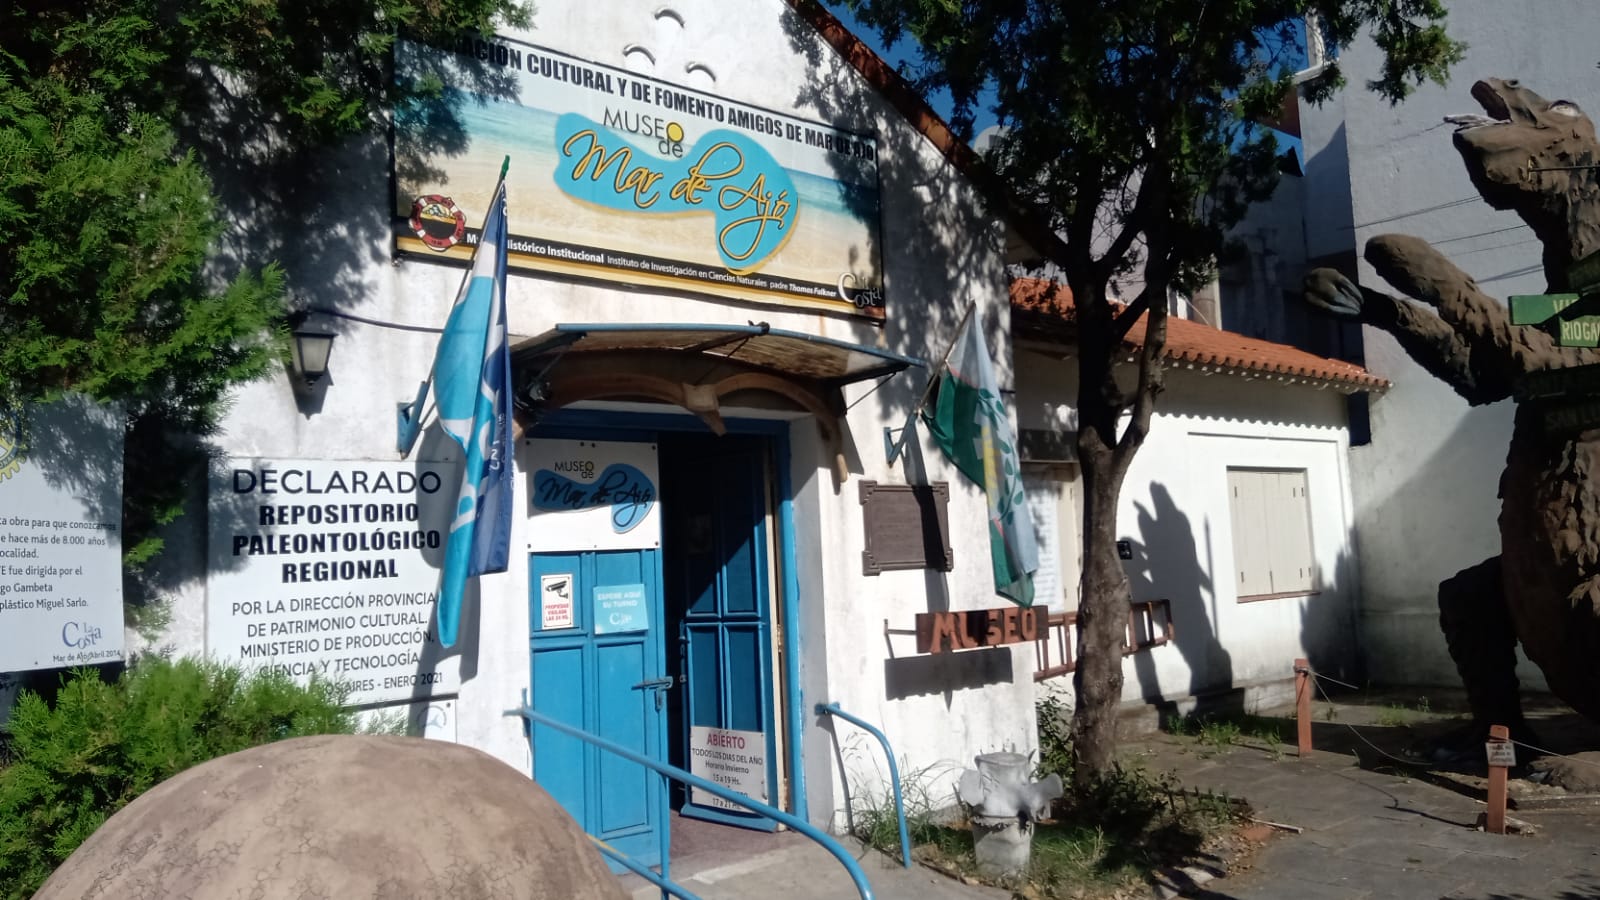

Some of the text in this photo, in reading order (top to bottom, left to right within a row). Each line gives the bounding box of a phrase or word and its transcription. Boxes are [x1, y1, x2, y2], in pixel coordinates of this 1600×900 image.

[526, 53, 614, 94] CULTURAL
[617, 78, 628, 97] Y
[631, 83, 651, 104] DE
[655, 88, 724, 122] FOMENTO
[728, 107, 783, 138] AMIGOS
[786, 123, 802, 142] DE
[805, 129, 833, 150] MAR
[836, 136, 851, 155] DE
[603, 106, 684, 143] MUSEO
[658, 138, 684, 159] de
[562, 129, 792, 261] Mar de Ajó
[547, 247, 604, 264] Institucional
[607, 255, 639, 269] Instituto
[640, 260, 650, 270] de
[651, 262, 697, 277] Investigación
[698, 271, 708, 279] en
[708, 271, 736, 283] Ciencias
[736, 275, 768, 287] Naturales
[769, 281, 789, 291] padre
[789, 283, 813, 294] Thomas
[838, 273, 882, 308] Costa
[1561, 321, 1582, 341] RIO
[554, 460, 594, 473] MUSEO
[581, 470, 594, 478] de
[233, 469, 442, 494] DECLARADO
[540, 477, 587, 509] Mar
[590, 470, 627, 503] de
[9, 516, 30, 526] obra
[31, 519, 50, 529] para
[52, 520, 68, 530] que
[259, 503, 419, 526] REPOSITORIO
[8, 532, 29, 543] hace
[31, 534, 48, 545] más
[50, 534, 60, 545] de
[62, 535, 85, 545] 8.000
[87, 536, 106, 546] años
[232, 528, 440, 556] PALEONTOLÓGICO
[8, 565, 23, 575] fue
[25, 565, 57, 578] dirigida
[59, 568, 72, 578] por
[74, 565, 82, 575] el
[282, 558, 399, 583] REGIONAL
[0, 582, 53, 595] go Gambeta
[36, 598, 64, 611] Miguel
[232, 592, 436, 616] POR LA DIRECCIÓN PROVINCIA
[62, 621, 102, 649] Costa
[247, 611, 428, 638] DE PATRIMONIO CULTURAL.
[929, 607, 1037, 655] MUSEO
[67, 652, 75, 661] de
[240, 639, 319, 659] MINISTERIO
[324, 636, 342, 651] DE
[260, 648, 420, 679] CIENCIA Y TECNOLOGÍA
[344, 679, 375, 693] AIRES
[384, 675, 417, 689] ENERO
[421, 672, 443, 686] 2021
[707, 733, 746, 750] ABIERTO
[692, 747, 712, 758] TODOS
[712, 751, 722, 760] LOS
[723, 752, 735, 762] DIAS
[736, 754, 747, 764] DEL
[726, 763, 750, 774] Invierno
